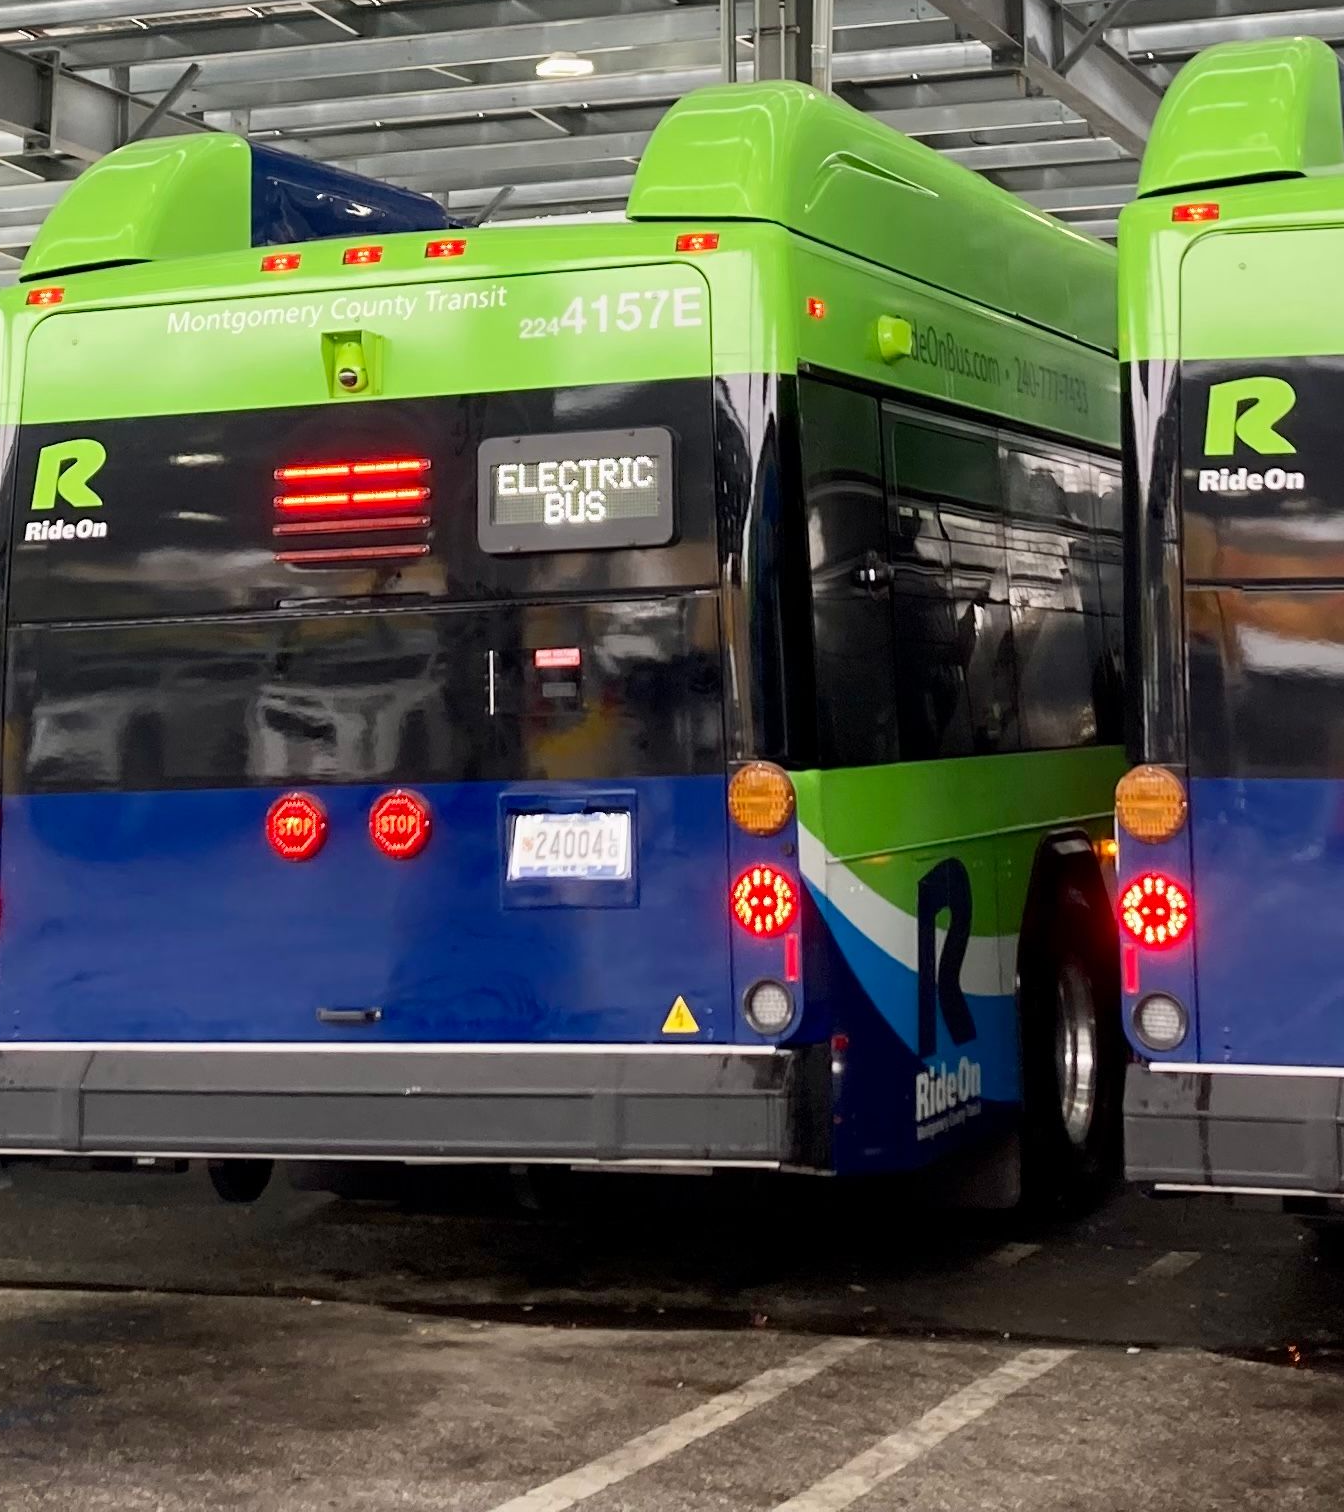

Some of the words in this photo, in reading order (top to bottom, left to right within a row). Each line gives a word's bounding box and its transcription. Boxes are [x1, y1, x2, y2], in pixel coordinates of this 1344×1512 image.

[166, 303, 322, 335] Montgomery
[329, 296, 420, 323] County
[425, 285, 508, 312] Transit
[498, 456, 654, 496] ELECTRIC
[1198, 468, 1305, 492] RideOn
[544, 490, 606, 525] BUS
[24, 519, 108, 541] RideOn
[277, 817, 313, 837] STOP
[380, 814, 416, 834] STOP
[534, 829, 605, 861] 24004
[915, 1055, 981, 1122] RideOn
